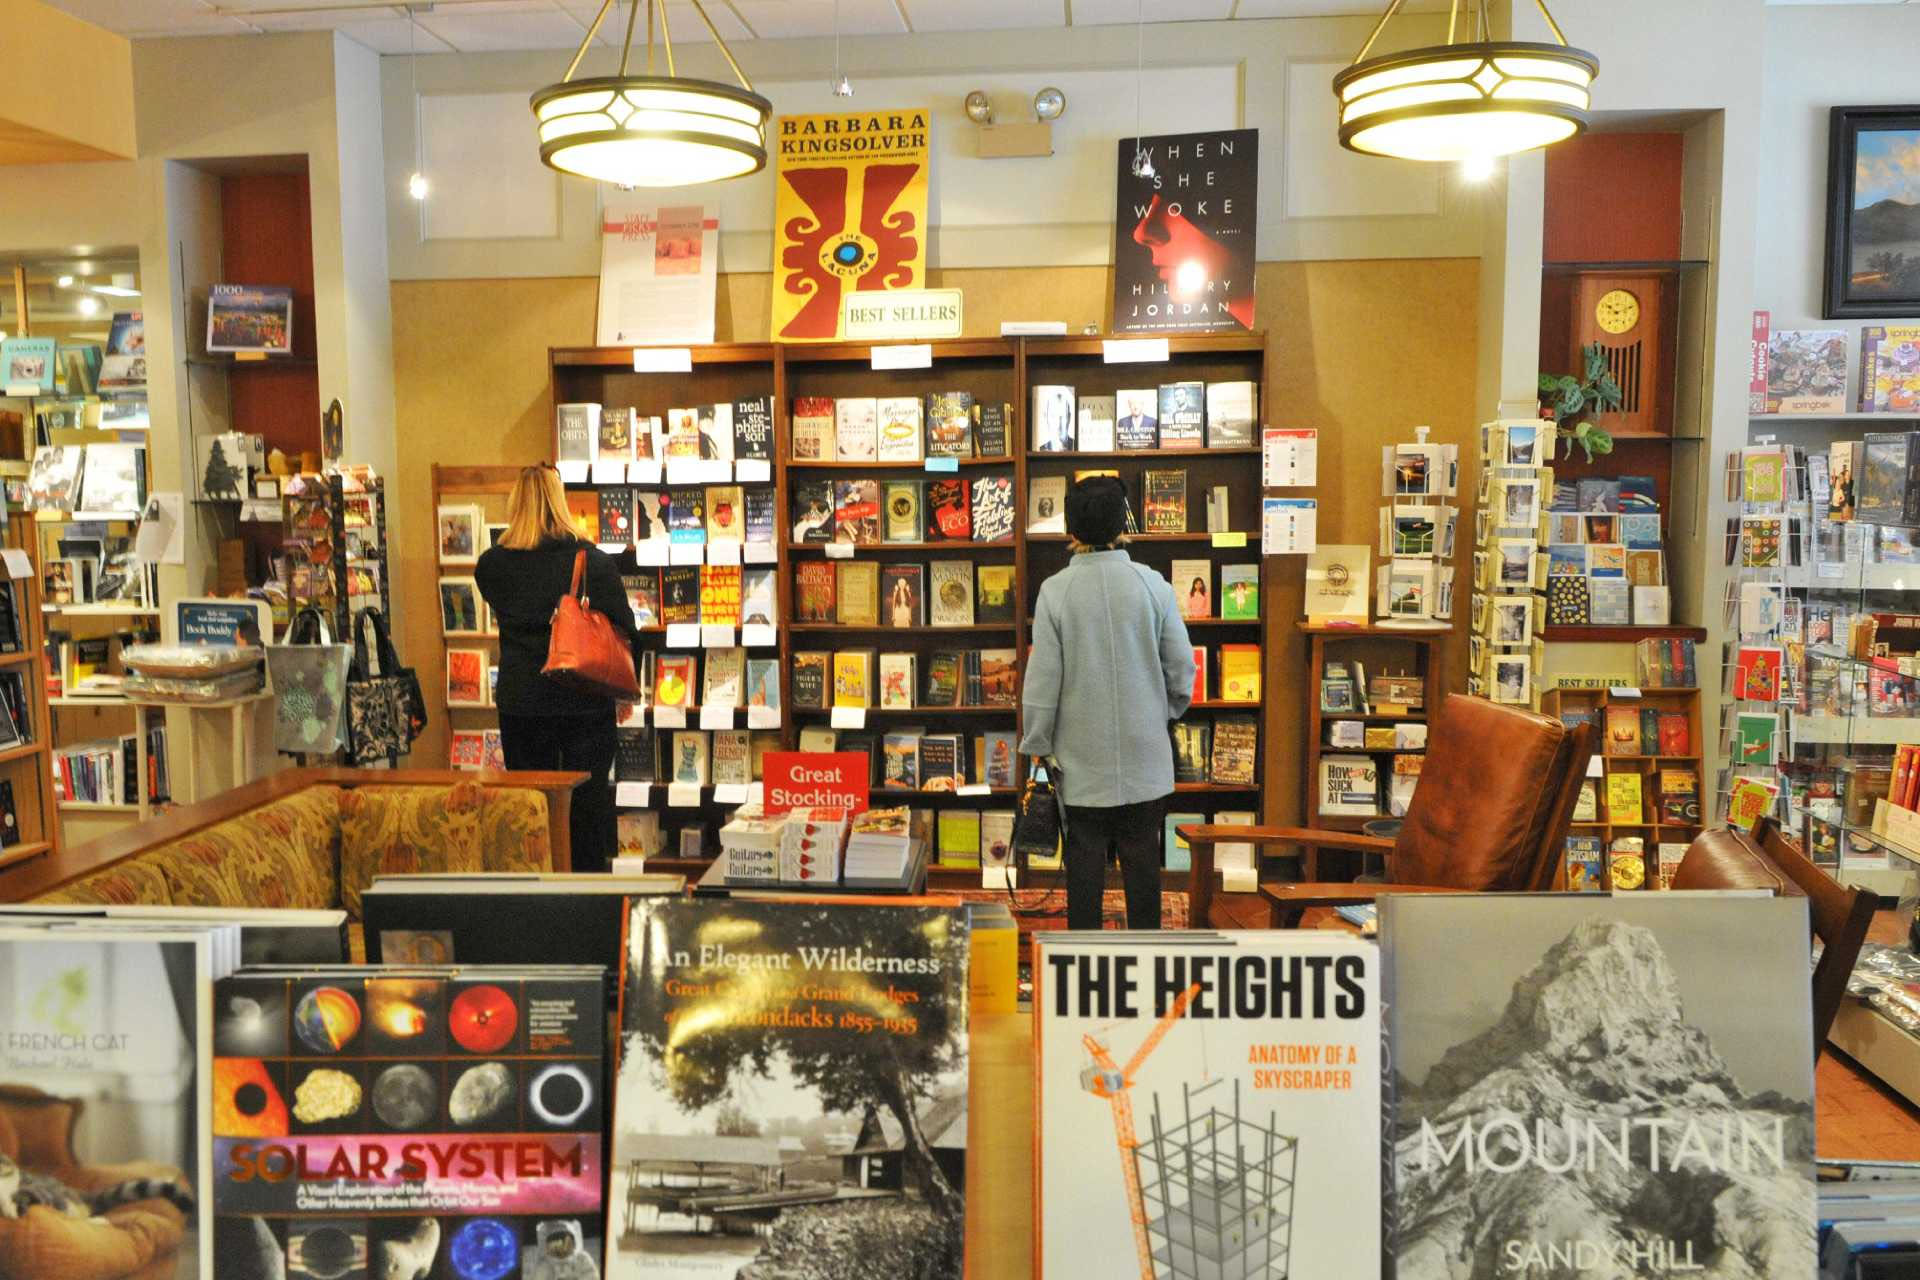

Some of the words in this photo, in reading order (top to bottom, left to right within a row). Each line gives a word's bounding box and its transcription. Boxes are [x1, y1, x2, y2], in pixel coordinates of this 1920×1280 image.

[782, 114, 925, 135] BARBARA
[782, 134, 925, 153] KINGSOLVER
[1136, 141, 1234, 160] WHEN
[1153, 171, 1215, 189] SHE
[1134, 199, 1232, 219] WOKE
[840, 233, 861, 241] THE
[821, 252, 877, 275] LACUNA
[214, 284, 243, 295] 1000
[1132, 280, 1231, 295] HILRY
[850, 308, 885, 323] BEST
[893, 305, 957, 320] SELLERS
[1132, 301, 1230, 317] JORDAN
[8, 344, 50, 353] CAMERAS
[1758, 342, 1767, 380] Cookie
[1864, 352, 1875, 399] Cupcakes
[739, 397, 764, 413] neal
[565, 416, 583, 429] THE
[749, 413, 770, 424] ste-
[736, 419, 771, 438] phen-
[745, 432, 766, 442] son
[945, 431, 957, 441] THE
[941, 515, 968, 531] ECO
[802, 565, 826, 574] DAVID
[797, 574, 832, 584] BALDACCI
[702, 587, 739, 603] ONE
[1558, 679, 1581, 688] BEST
[1585, 679, 1627, 688] SELLERS
[790, 766, 842, 783] Great
[1328, 780, 1353, 792] SUCK
[771, 789, 862, 809] Stocking-
[700, 944, 792, 976] Elegant
[798, 946, 940, 974] Wilderness
[665, 979, 710, 997] Great
[802, 983, 855, 1001] Grand
[1049, 955, 1138, 1018] THE
[1154, 955, 1365, 1020] HEIGHTS
[8, 1032, 87, 1050] FRENCH
[92, 1032, 130, 1051] CAT
[1249, 1045, 1320, 1064] ANATOMY
[1326, 1045, 1344, 1063] OF
[1347, 1046, 1357, 1063] A
[1254, 1070, 1352, 1090] SKYSCRAPER
[1419, 1116, 1784, 1174] MOUNTAIN
[229, 1143, 387, 1182] SOLAR
[401, 1142, 582, 1181] SYSTEM
[297, 1185, 306, 1196] A
[308, 1184, 336, 1197] Visual
[338, 1184, 398, 1198] Exploration
[407, 1183, 422, 1196] the
[297, 1196, 326, 1209] Other
[330, 1196, 373, 1211] Heavenly
[377, 1195, 408, 1209] Bodies
[411, 1195, 429, 1208] that
[432, 1195, 458, 1210] Orbit
[459, 1196, 480, 1208] Our
[482, 1195, 501, 1208] Sun
[1505, 1240, 1620, 1271] SANDY
[1627, 1240, 1705, 1270] HILL
